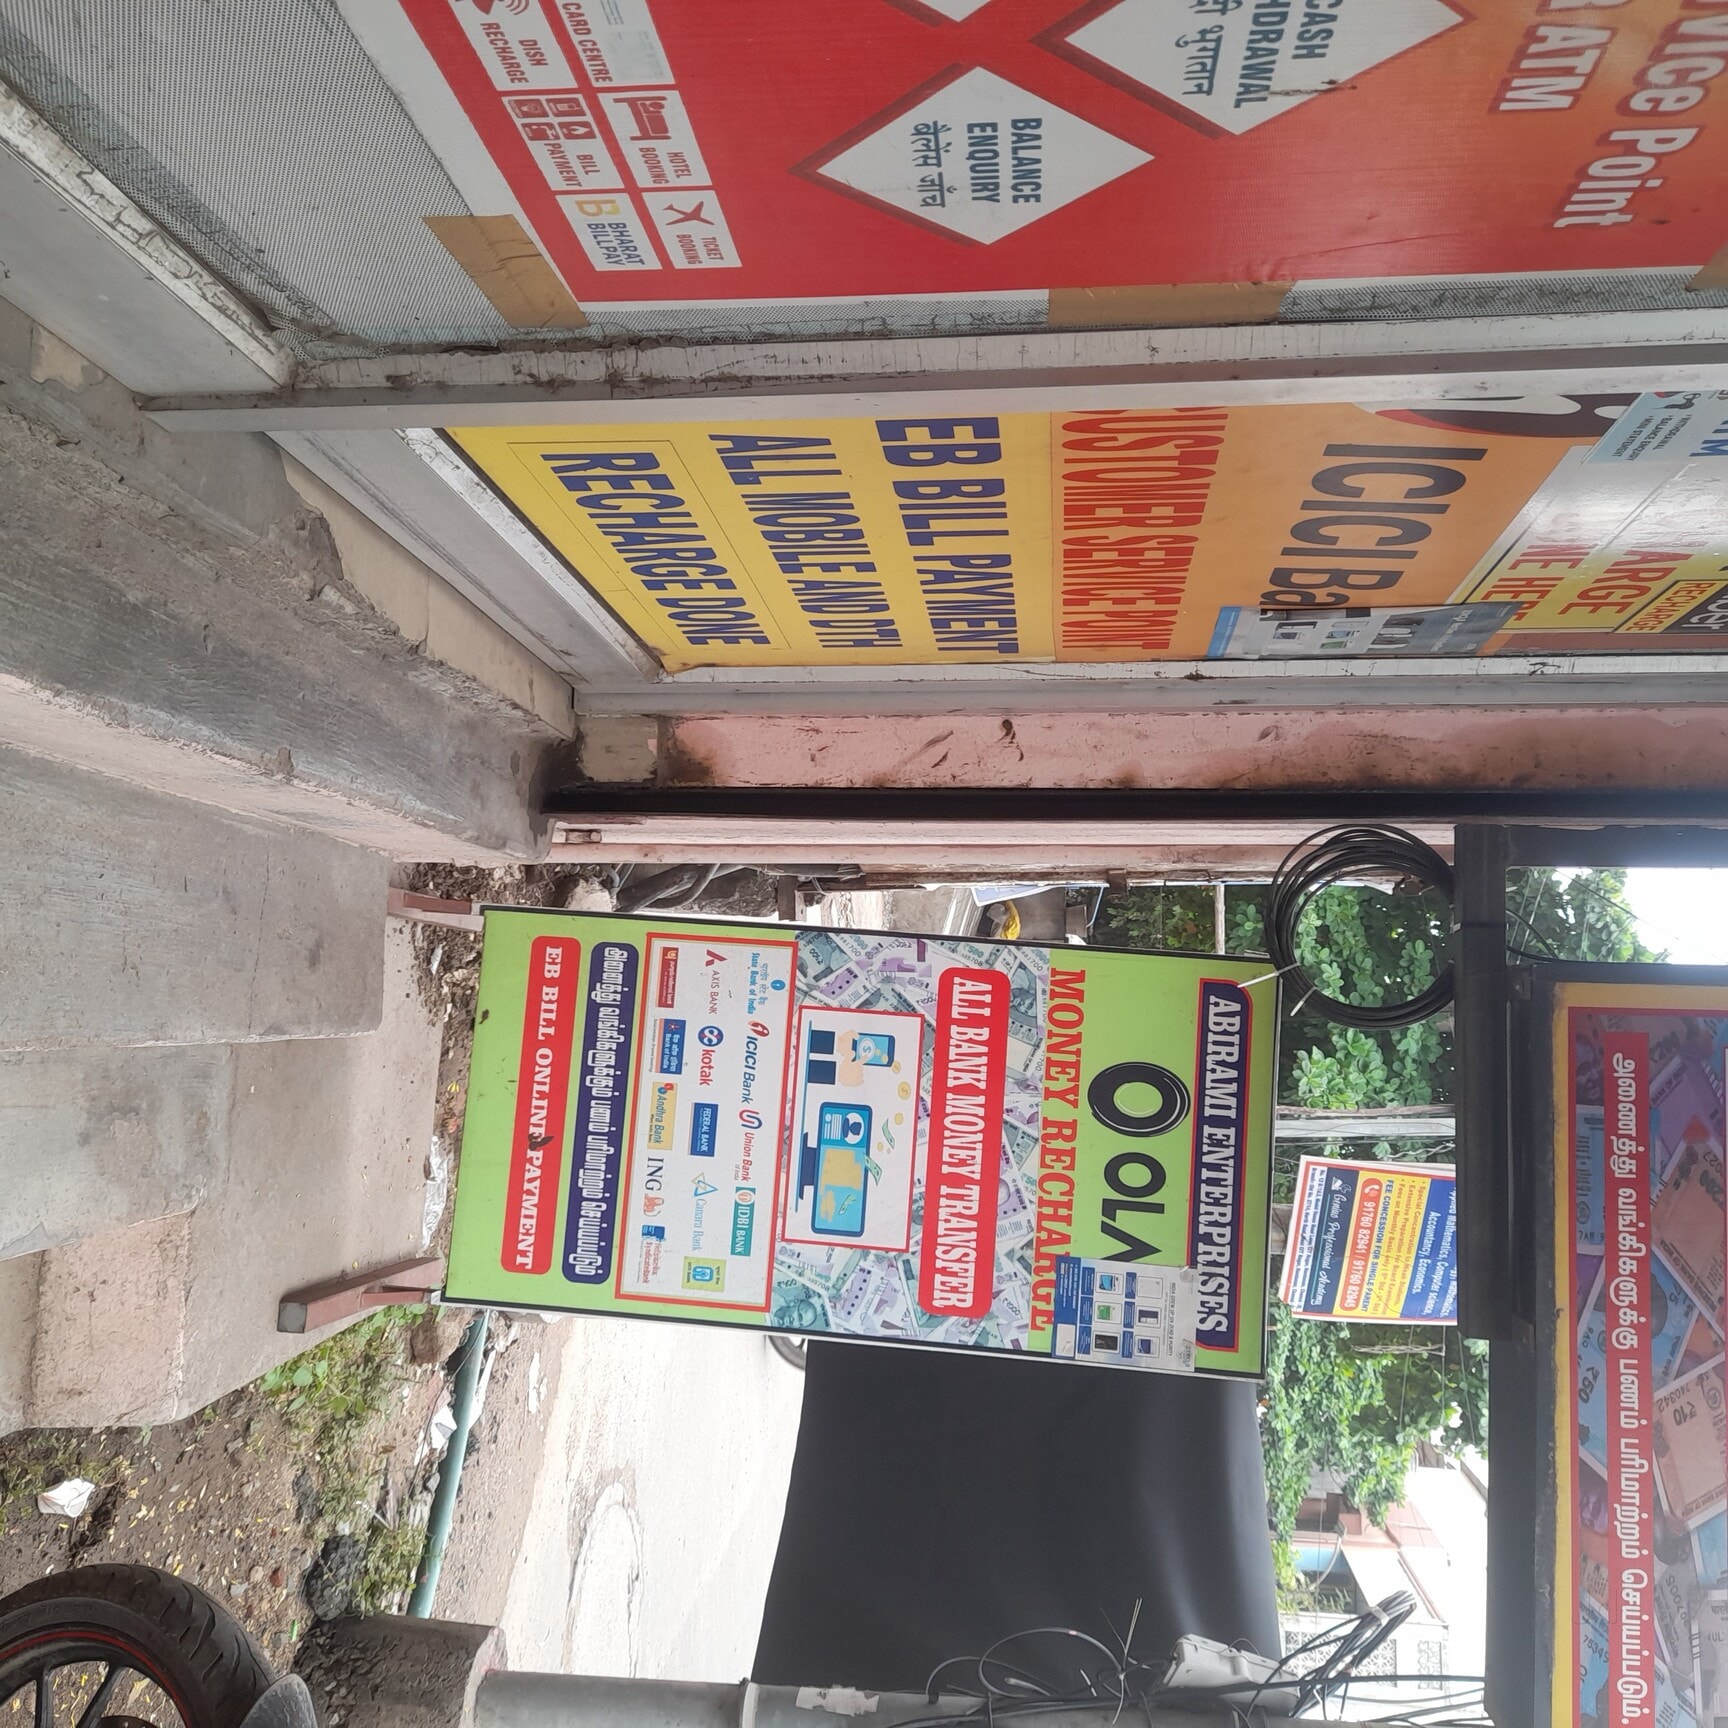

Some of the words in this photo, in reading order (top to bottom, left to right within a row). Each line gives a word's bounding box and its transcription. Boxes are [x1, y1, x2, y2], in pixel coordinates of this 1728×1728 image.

[480, 22, 530, 84] RECHARGE
[517, 39, 550, 67] DISH
[561, 2, 593, 36] CARD
[577, 39, 614, 83] CENTRE
[1175, 24, 1225, 97] भुगतान
[1629, 0, 1728, 112] vice
[1499, 26, 1612, 111] ATM
[910, 120, 953, 168] बैलेंस
[965, 122, 1001, 203] ENQUIRY
[1010, 117, 1042, 204] BALANCE
[543, 143, 583, 188] PAYMENT
[575, 154, 601, 176] BILL
[638, 147, 670, 185] BOOKING
[666, 151, 693, 179] HOTEL
[1553, 127, 1699, 228] Point
[915, 172, 959, 208] जाँच
[586, 222, 624, 266] BILLPAY
[607, 222, 645, 266] BHARAT
[675, 234, 703, 265] BOOKING
[700, 236, 725, 261] TICKET
[874, 416, 1003, 468] EB
[1611, 430, 1644, 458] STATEMENT
[1643, 417, 1673, 441] BALANCE
[707, 434, 843, 486] ALL
[892, 478, 1010, 547] BILL
[1279, 444, 1489, 560] ICICI
[540, 452, 738, 591] RECHARGE
[654, 597, 772, 646] DONE
[740, 492, 878, 575] MOBILE
[1060, 534, 1200, 607] SERVICE
[1507, 542, 1599, 571] NE
[786, 579, 891, 614] AND
[1259, 567, 1405, 608] Ba
[1480, 576, 1566, 621] HE
[1557, 545, 1700, 615] ARGE
[912, 553, 1020, 654] PAYMENT
[1624, 582, 1718, 632] RECHARGE
[807, 618, 904, 648] DTH
[1060, 609, 1178, 650] POINT
[543, 946, 563, 979] EB
[749, 970, 759, 987] Bank
[750, 952, 761, 968] State
[710, 969, 721, 989] AXIS
[749, 988, 757, 996] of
[537, 985, 560, 1041] BILL
[708, 991, 720, 1015] BANK
[746, 997, 756, 1015] India
[951, 976, 993, 1020] ALL
[584, 1006, 626, 1098] வங்கிகளுக்கும்
[664, 1033, 672, 1047] Bank
[744, 1035, 759, 1070] ICICI
[946, 1024, 989, 1090] BANK
[1041, 968, 1087, 1110] MONEY
[1202, 995, 1242, 1117] ABIRAMI
[662, 1055, 670, 1069] India
[698, 1049, 716, 1086] kotak
[741, 1071, 755, 1105] Bank
[587, 1099, 617, 1133] பணம்
[655, 1094, 667, 1123] Andhra
[701, 1107, 712, 1133] FEDERAL
[652, 1124, 665, 1145] Bank
[699, 1133, 709, 1152] BANK
[742, 1131, 755, 1158] Union
[940, 1093, 986, 1180] MONEY
[577, 1134, 615, 1200] பரிமாற்றம்
[644, 1156, 665, 1192] ING
[740, 1158, 753, 1182] Bank
[1384, 1179, 1395, 1194] FEE
[1396, 1183, 1406, 1200] Fees
[1403, 1184, 1416, 1217] Extensive
[1415, 1186, 1427, 1210] Special
[515, 1149, 544, 1270] PAYMENT
[693, 1199, 707, 1228] Canara
[736, 1205, 751, 1229] IDBI
[1100, 1152, 1167, 1264] OLA
[1330, 1193, 1347, 1219] Genius
[1359, 1201, 1377, 1228] 91760
[1375, 1195, 1392, 1243] CONCESSION
[1387, 1210, 1401, 1235] Monthly
[568, 1200, 608, 1276] செய்யப்படும்
[691, 1230, 705, 1252] Bank
[734, 1230, 747, 1254] BANK
[1030, 1118, 1078, 1332] RECHARGE
[1194, 1125, 1237, 1332] ENTERPRISES
[1354, 1228, 1371, 1254] 82941
[1395, 1217, 1411, 1254] Preparation
[1406, 1211, 1424, 1255] Concentration
[1417, 1211, 1442, 1258] Accountancy,
[641, 1241, 653, 1284] SyndicateBank
[931, 1184, 980, 1309] TRANSFER
[1322, 1221, 1341, 1269] Professional
[1372, 1244, 1383, 1260] FOR
[1385, 1236, 1396, 1254] Basis
[1349, 1260, 1365, 1285] 91760
[1366, 1261, 1379, 1287] SINGLE
[1411, 1258, 1432, 1295] Economics.
[1429, 1261, 1449, 1292] Computer
[1609, 1187, 1647, 1350] வங்கிகளுக்கு
[1311, 1270, 1331, 1306] Academy
[1343, 1285, 1360, 1308] 82945
[1360, 1287, 1373, 1313] PARENT
[1420, 1292, 1439, 1316] science,
[1618, 1358, 1648, 1430] பணம்
[1612, 1437, 1650, 1560] பரிமாற்றம்
[1615, 1567, 1651, 1726] செய்யப்படும்.
